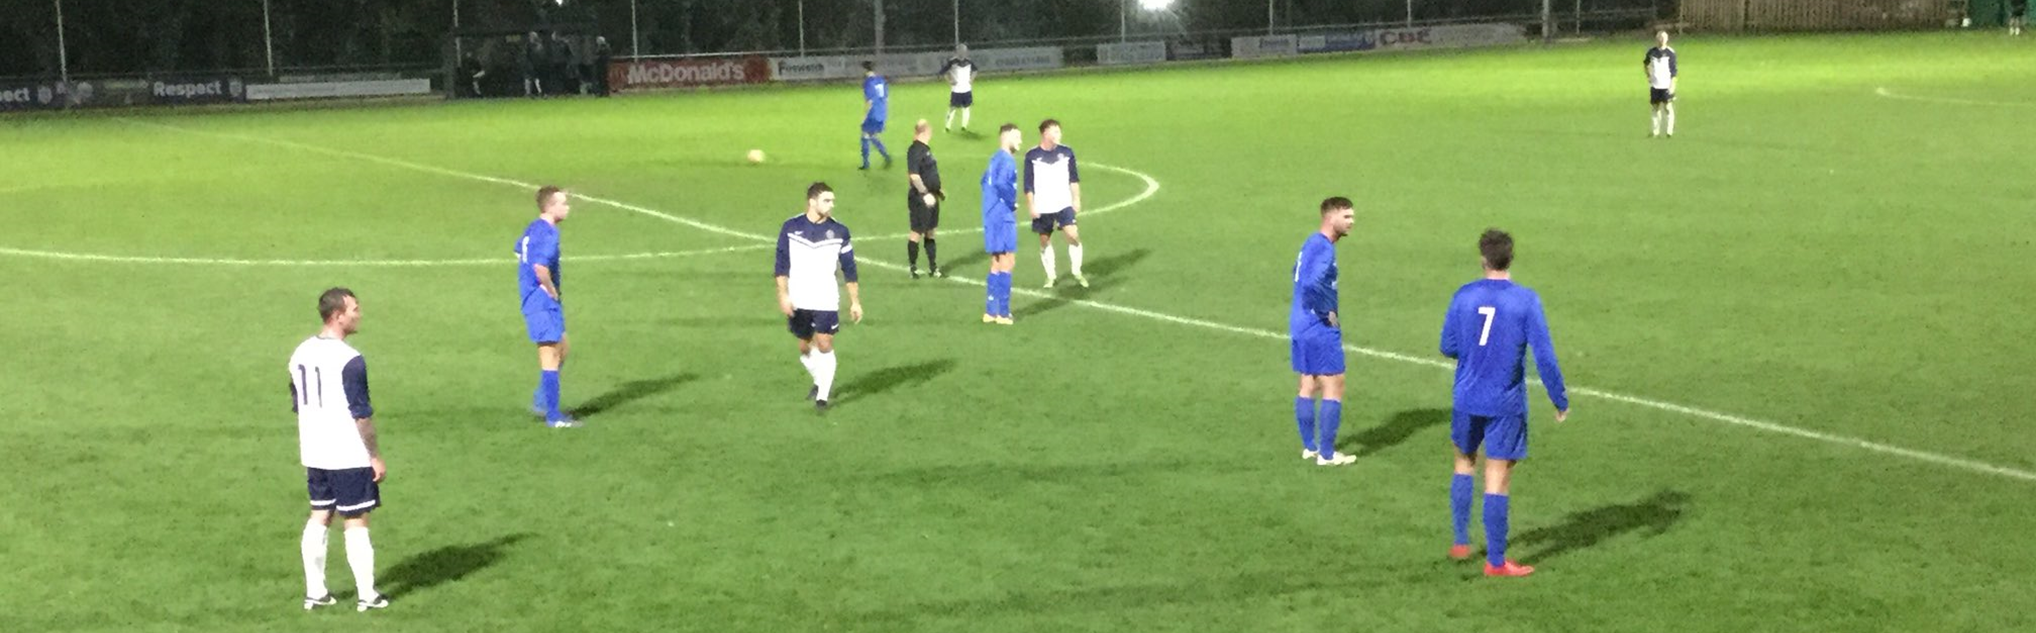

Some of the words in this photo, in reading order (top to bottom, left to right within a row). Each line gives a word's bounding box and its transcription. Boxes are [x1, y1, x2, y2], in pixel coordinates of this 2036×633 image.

[627, 61, 745, 84] McDonald's
[0, 87, 30, 102] ect
[153, 80, 222, 98] Respect
[1478, 306, 1496, 346] 7
[298, 364, 322, 408] 11
